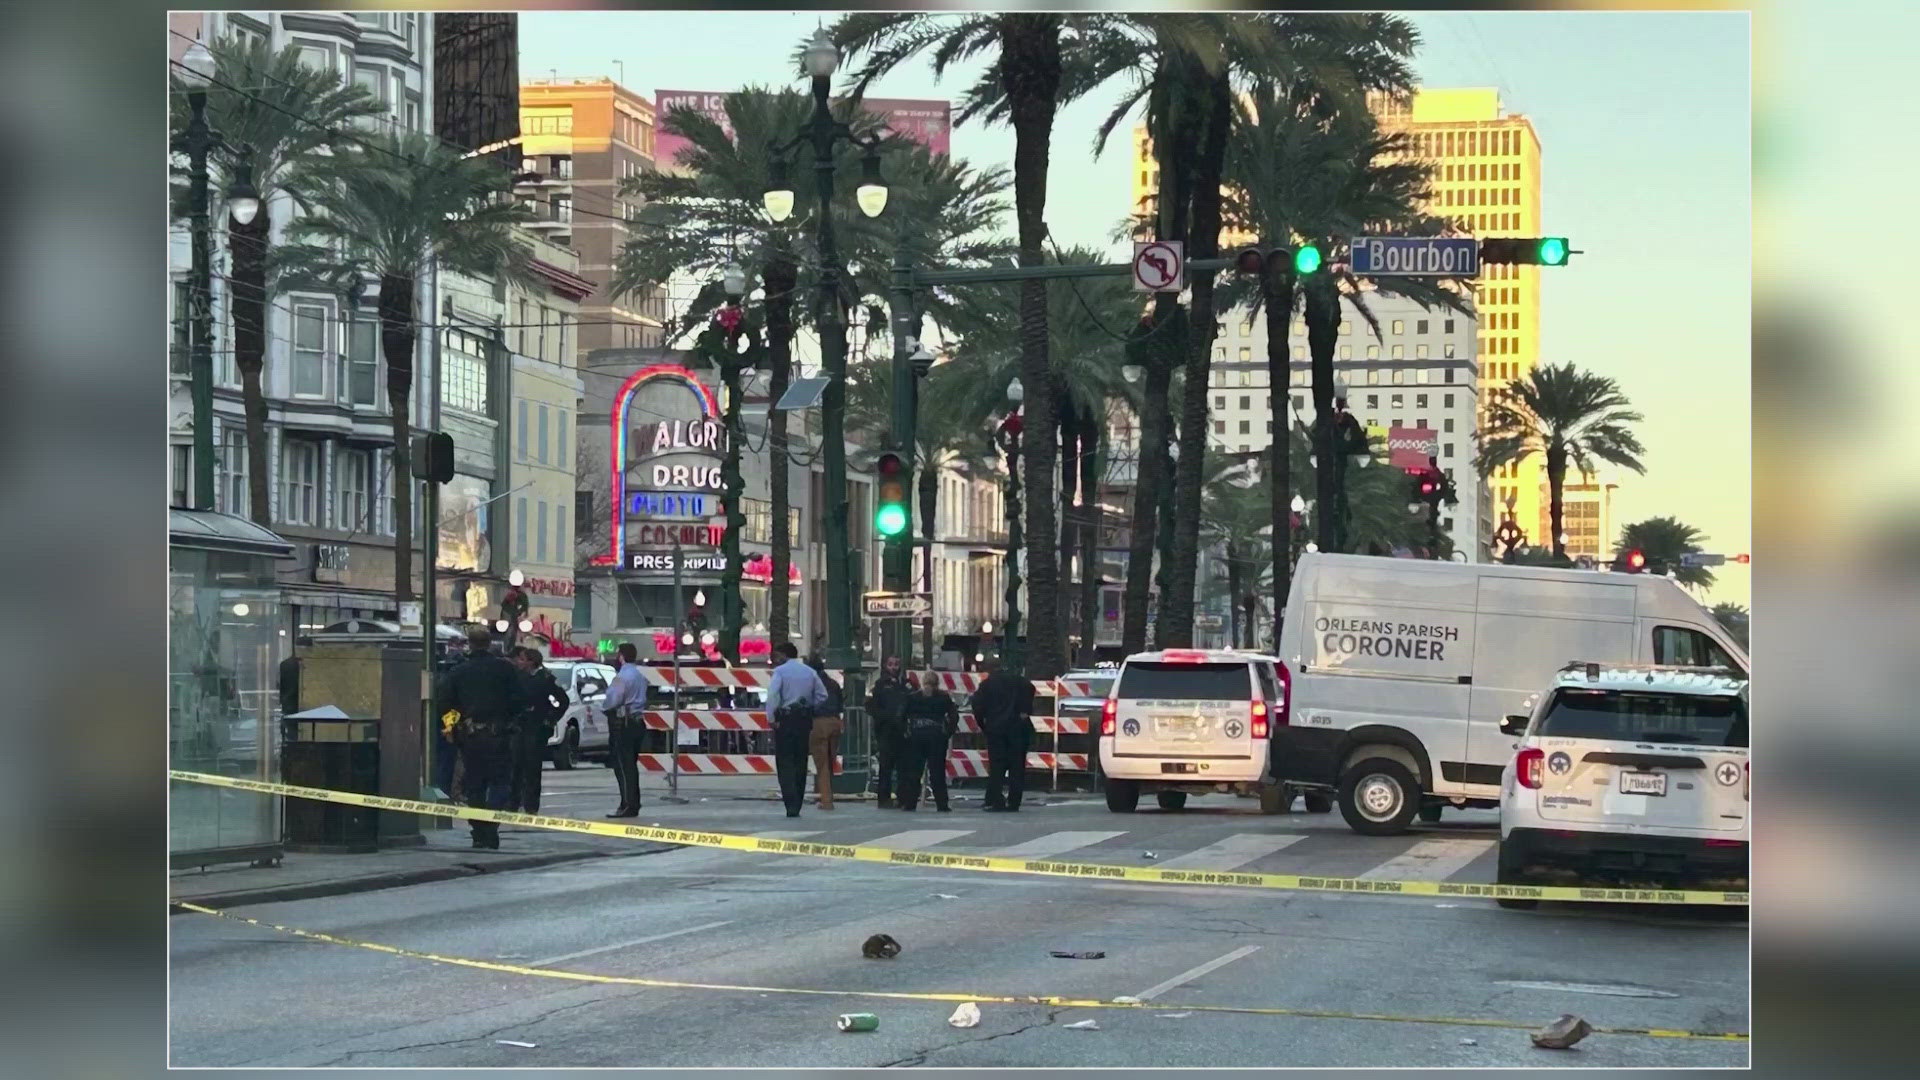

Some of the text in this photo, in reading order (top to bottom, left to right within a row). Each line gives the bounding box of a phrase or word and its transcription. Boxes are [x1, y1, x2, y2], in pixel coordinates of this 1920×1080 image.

[1369, 240, 1471, 272] Bourbon
[1315, 617, 1459, 641] ORLEANS PARISH
[1323, 633, 1444, 661] CORONER
